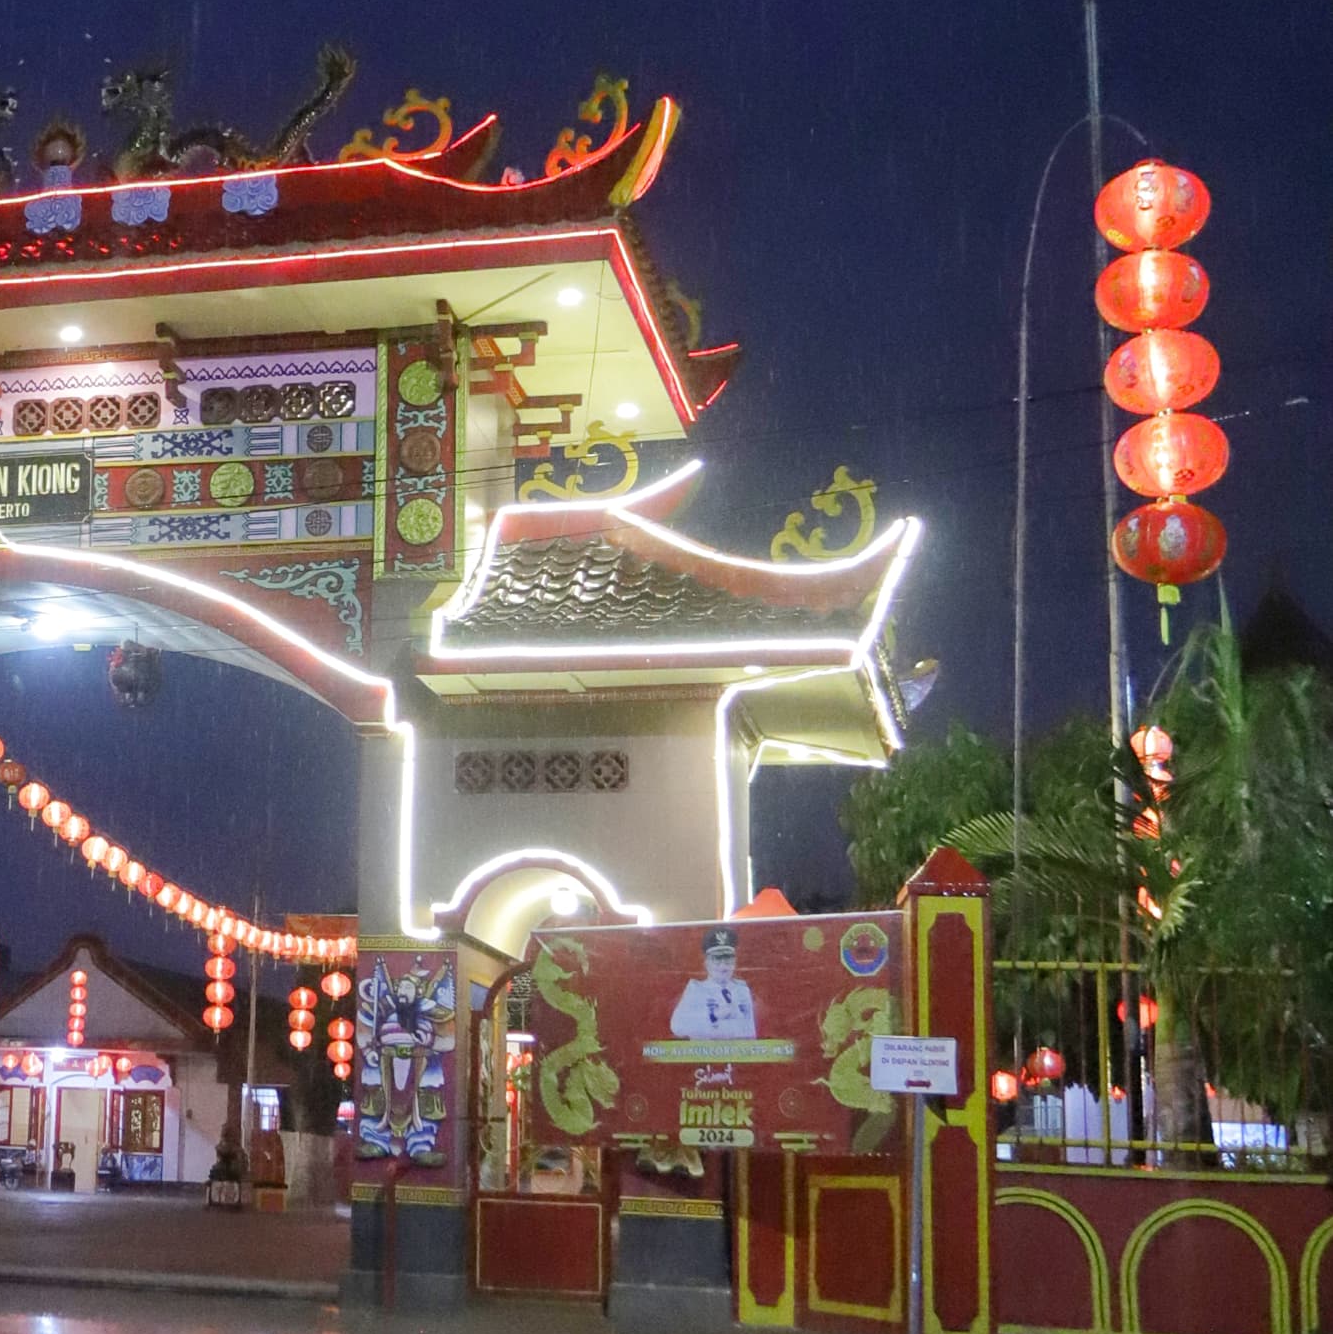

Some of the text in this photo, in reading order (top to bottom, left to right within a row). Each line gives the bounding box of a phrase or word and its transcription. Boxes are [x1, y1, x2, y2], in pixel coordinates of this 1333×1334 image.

[17, 463, 81, 497] KIONG
[680, 1086, 753, 1100] Tahun baru
[679, 1099, 754, 1127] Imlek
[698, 1129, 734, 1143] 2024
